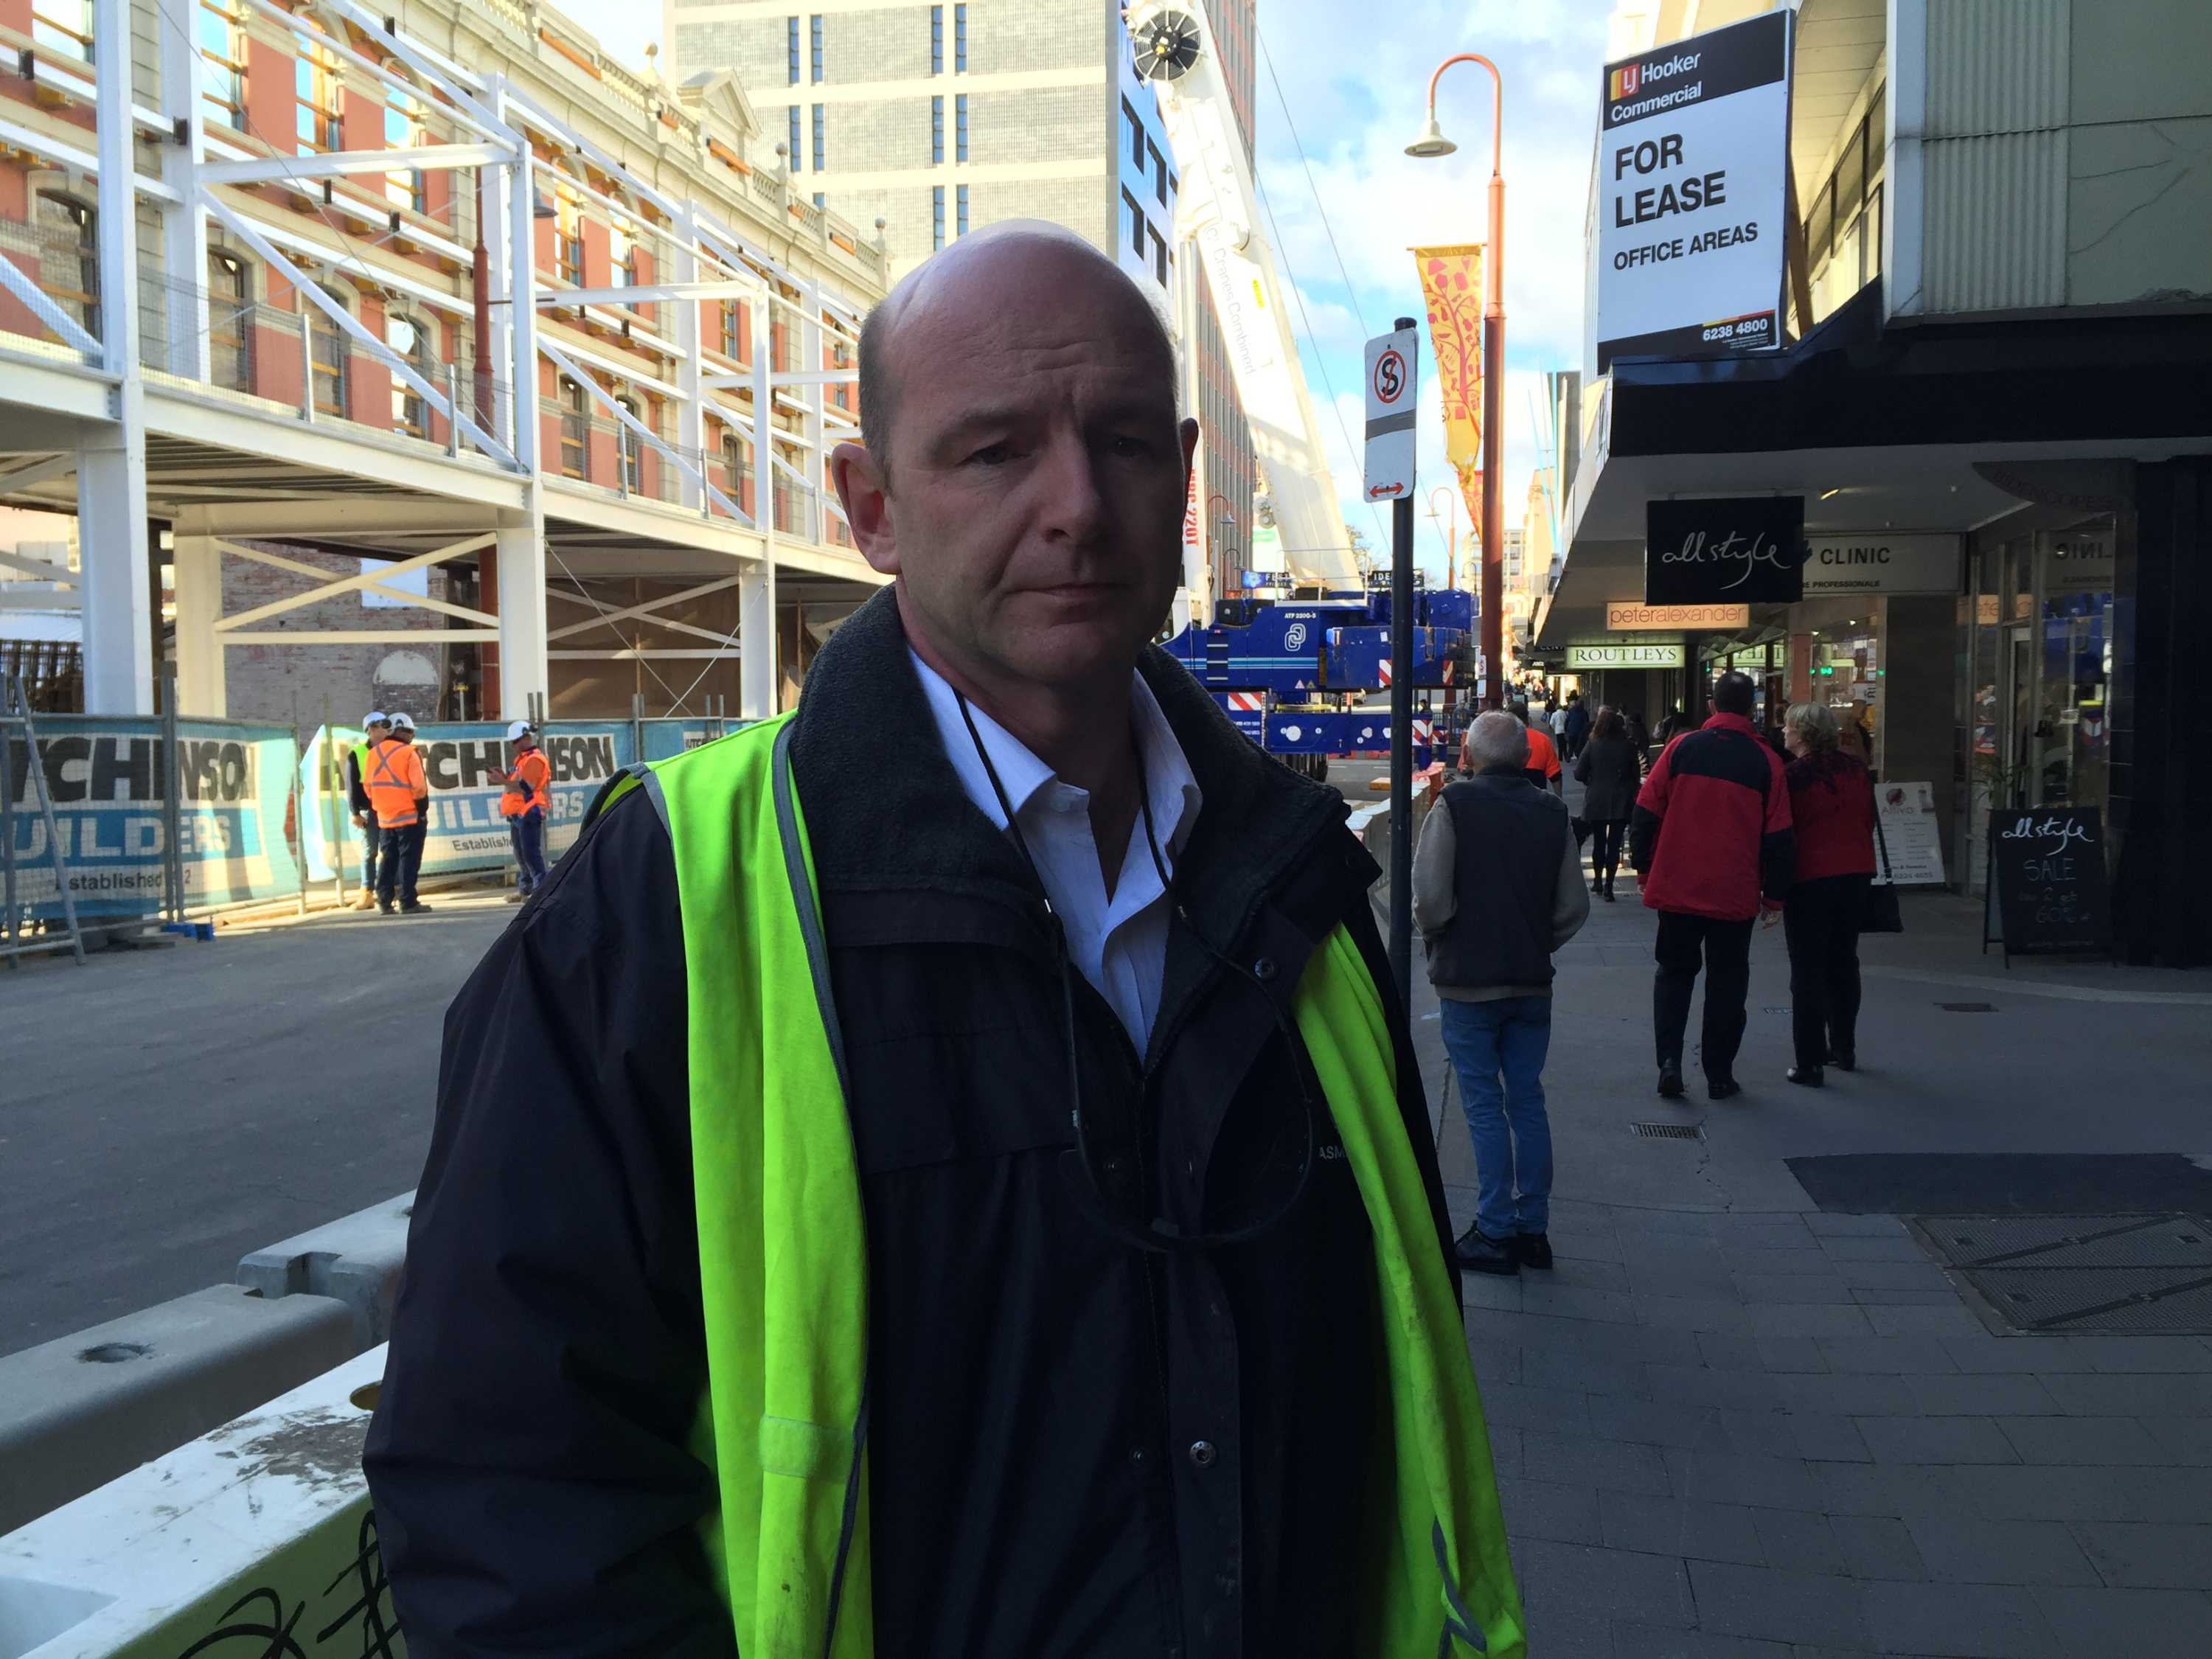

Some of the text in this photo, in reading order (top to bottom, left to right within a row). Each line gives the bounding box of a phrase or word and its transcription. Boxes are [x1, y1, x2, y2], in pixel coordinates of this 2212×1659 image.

[1641, 52, 1702, 85] Hooker
[1610, 80, 1703, 123] Commercial
[1615, 133, 1684, 181] FOR
[1615, 170, 1726, 229] LEASE
[1613, 222, 1759, 271] OFFICE AREAS
[1703, 324, 1733, 341] 6238
[1736, 318, 1769, 335] 4800
[1820, 547, 1891, 565] CLINIC
[1374, 572, 1393, 580] IDE
[1610, 605, 1745, 627] peteralexander
[1574, 647, 1677, 661] ROUTLEYS
[452, 837, 514, 852] Establish
[55, 869, 163, 891] stablished
[2023, 858, 2077, 882] SALE
[1319, 1144, 1346, 1160] ASM
